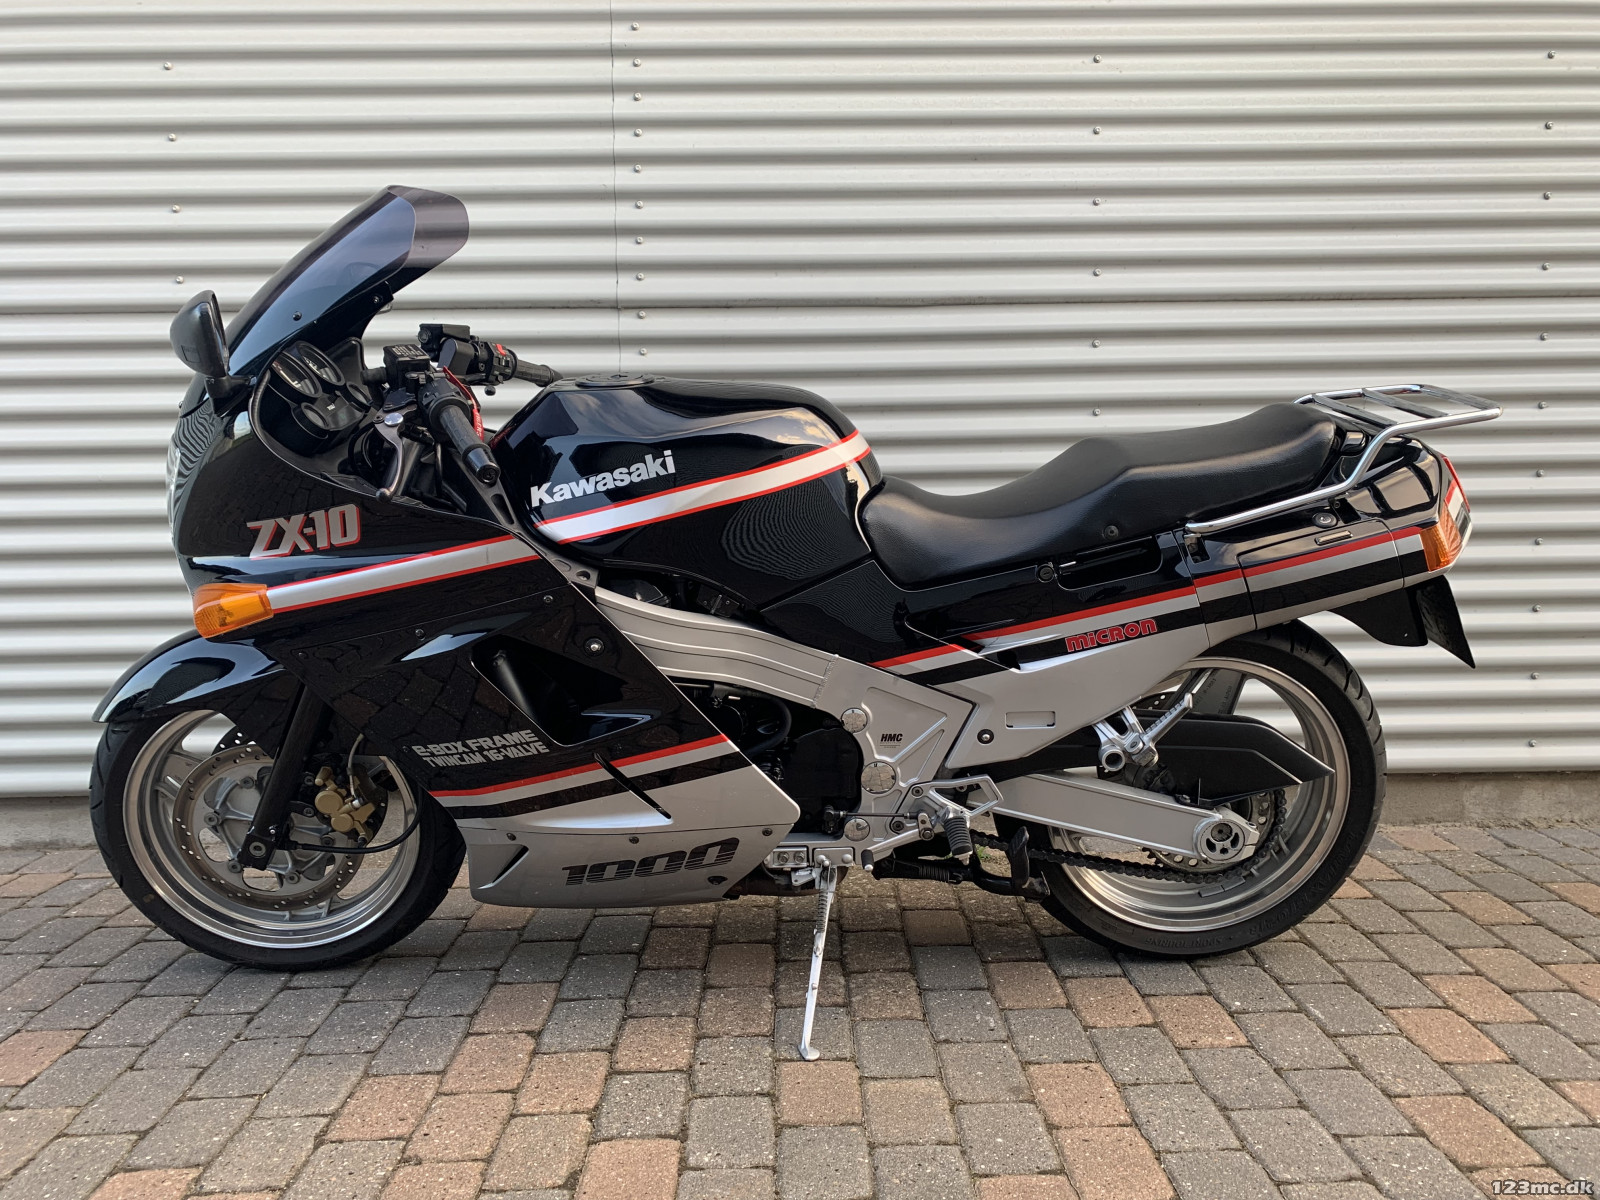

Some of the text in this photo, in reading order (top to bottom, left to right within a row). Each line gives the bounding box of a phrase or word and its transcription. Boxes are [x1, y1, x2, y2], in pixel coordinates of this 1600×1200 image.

[530, 450, 676, 508] Kawasaki
[246, 503, 361, 560] ZX-10
[422, 741, 550, 768] TWINCAM 16-VALVE
[465, 729, 540, 751] FRAME
[880, 733, 904, 742] HMC
[561, 836, 741, 886] 1000
